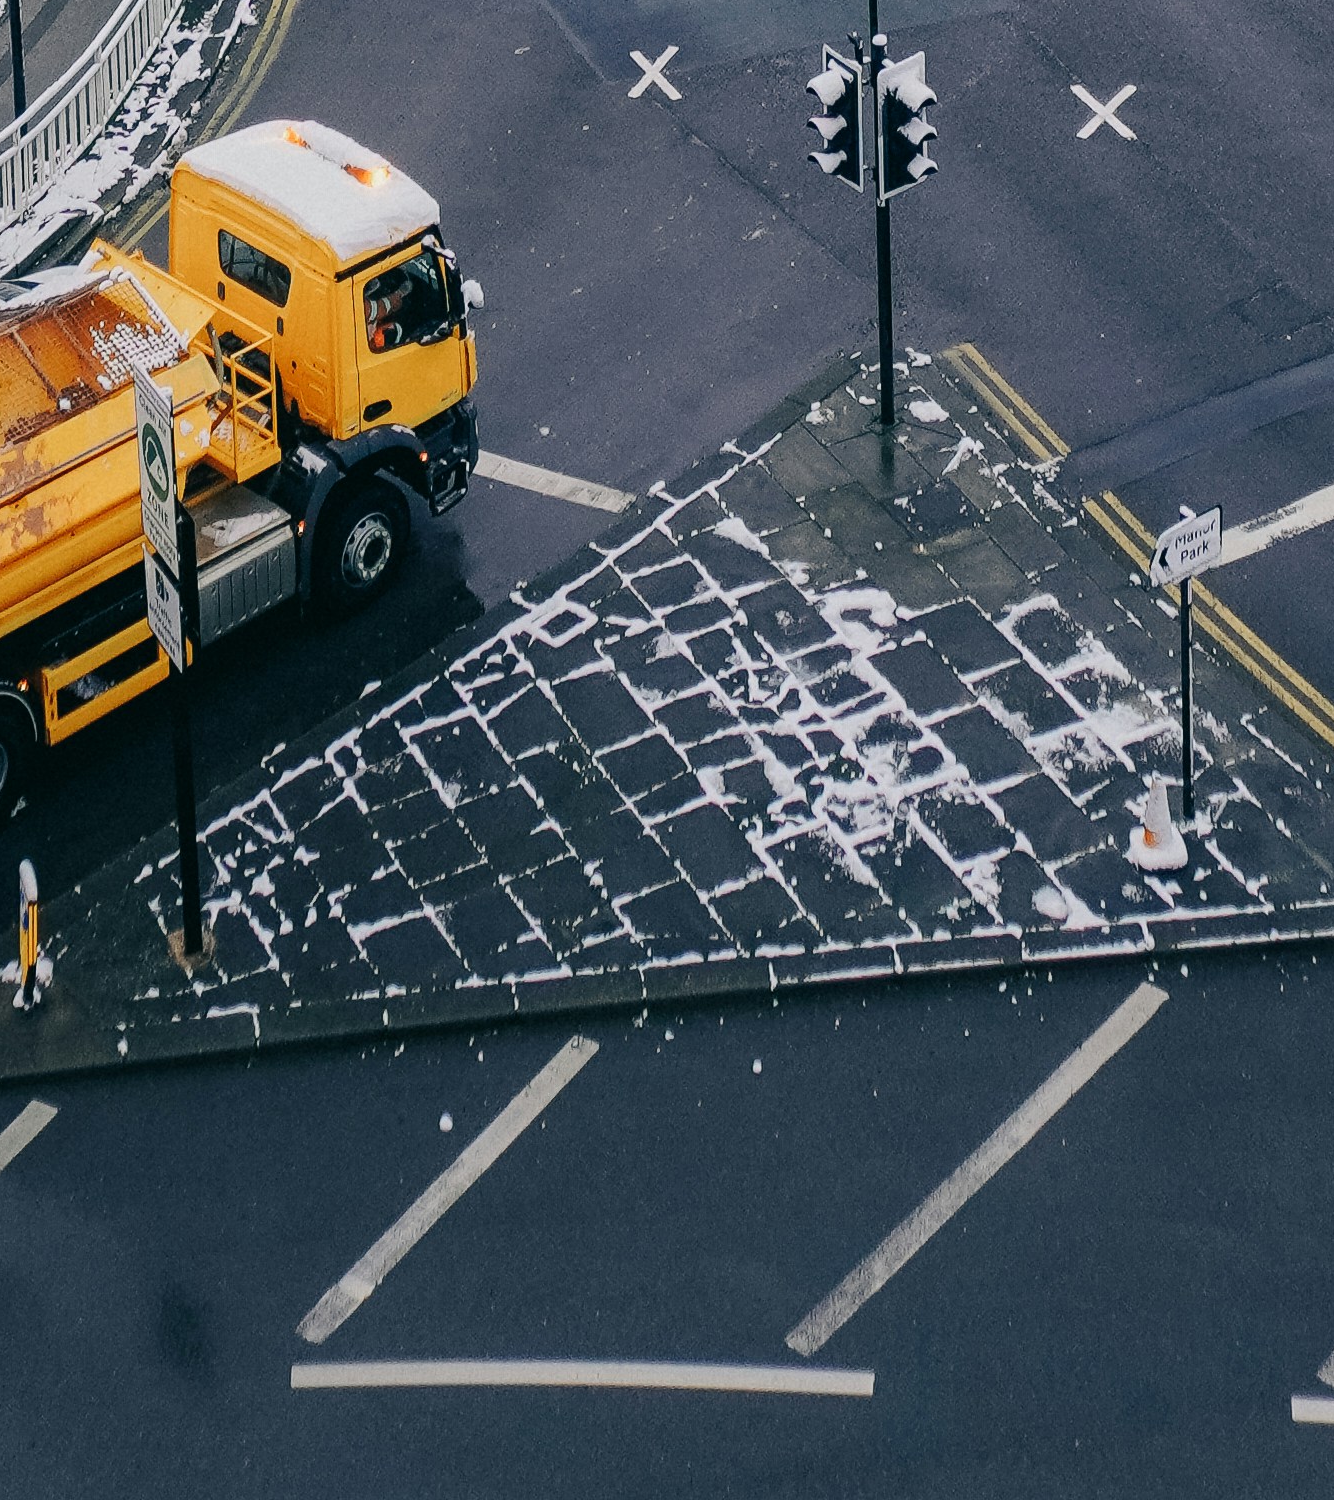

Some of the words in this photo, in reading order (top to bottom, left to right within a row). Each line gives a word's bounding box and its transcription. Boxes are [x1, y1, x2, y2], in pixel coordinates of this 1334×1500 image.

[147, 488, 169, 530] ZONE
[1174, 518, 1216, 550] Manor
[1180, 539, 1209, 565] Park
